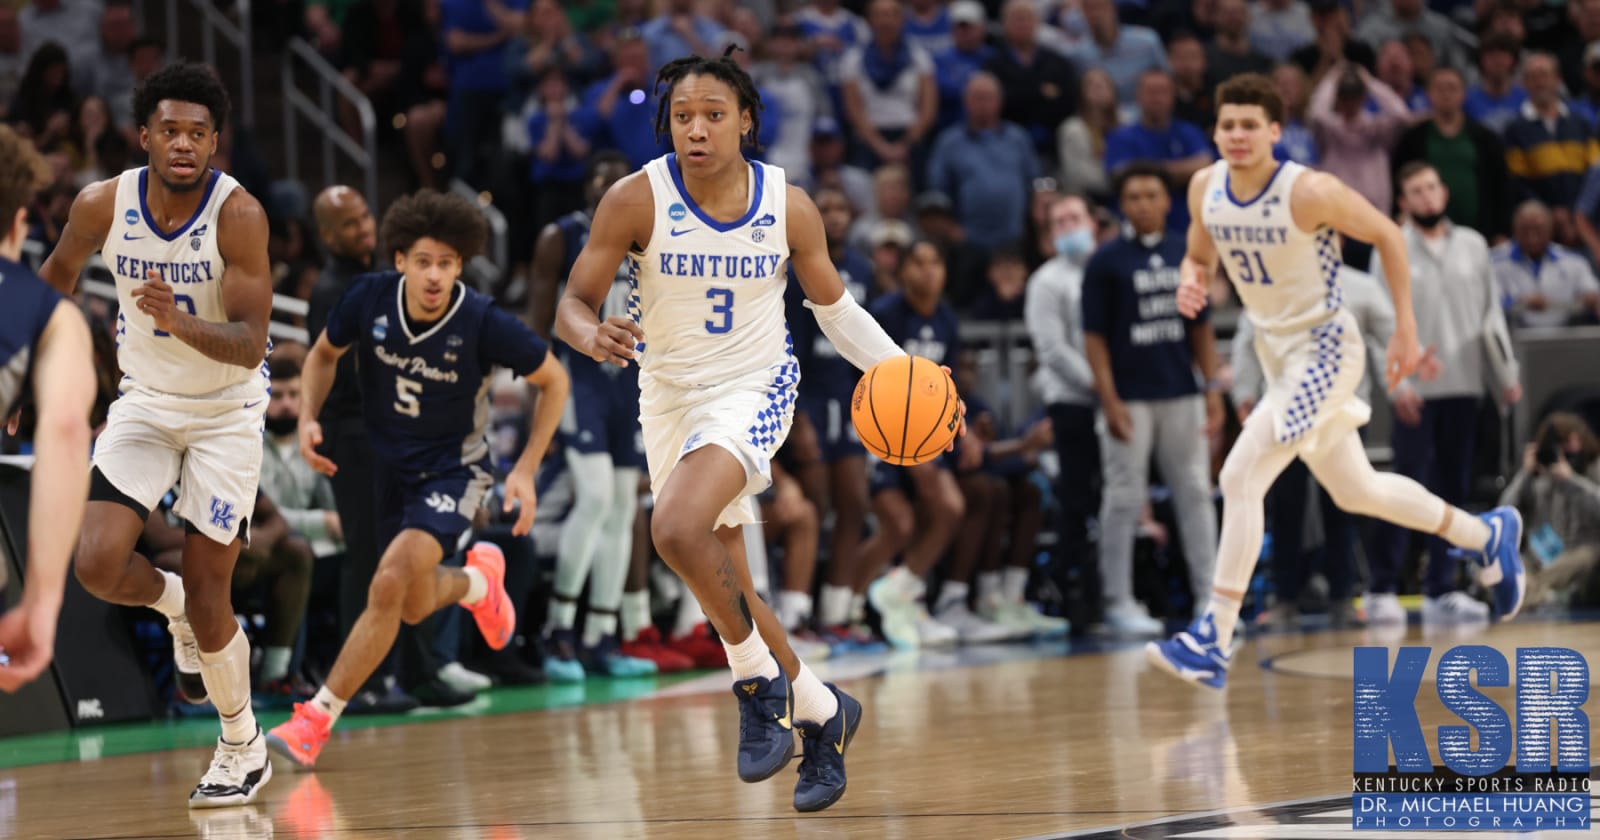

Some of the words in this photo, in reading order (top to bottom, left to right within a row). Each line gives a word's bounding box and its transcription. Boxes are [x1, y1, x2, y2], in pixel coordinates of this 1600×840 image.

[116, 255, 213, 284] KENTUCKY
[660, 253, 781, 278] KENTUCKY
[1230, 249, 1273, 284] 31
[705, 287, 734, 334] 3
[393, 375, 423, 418] 5
[210, 496, 237, 532] UK
